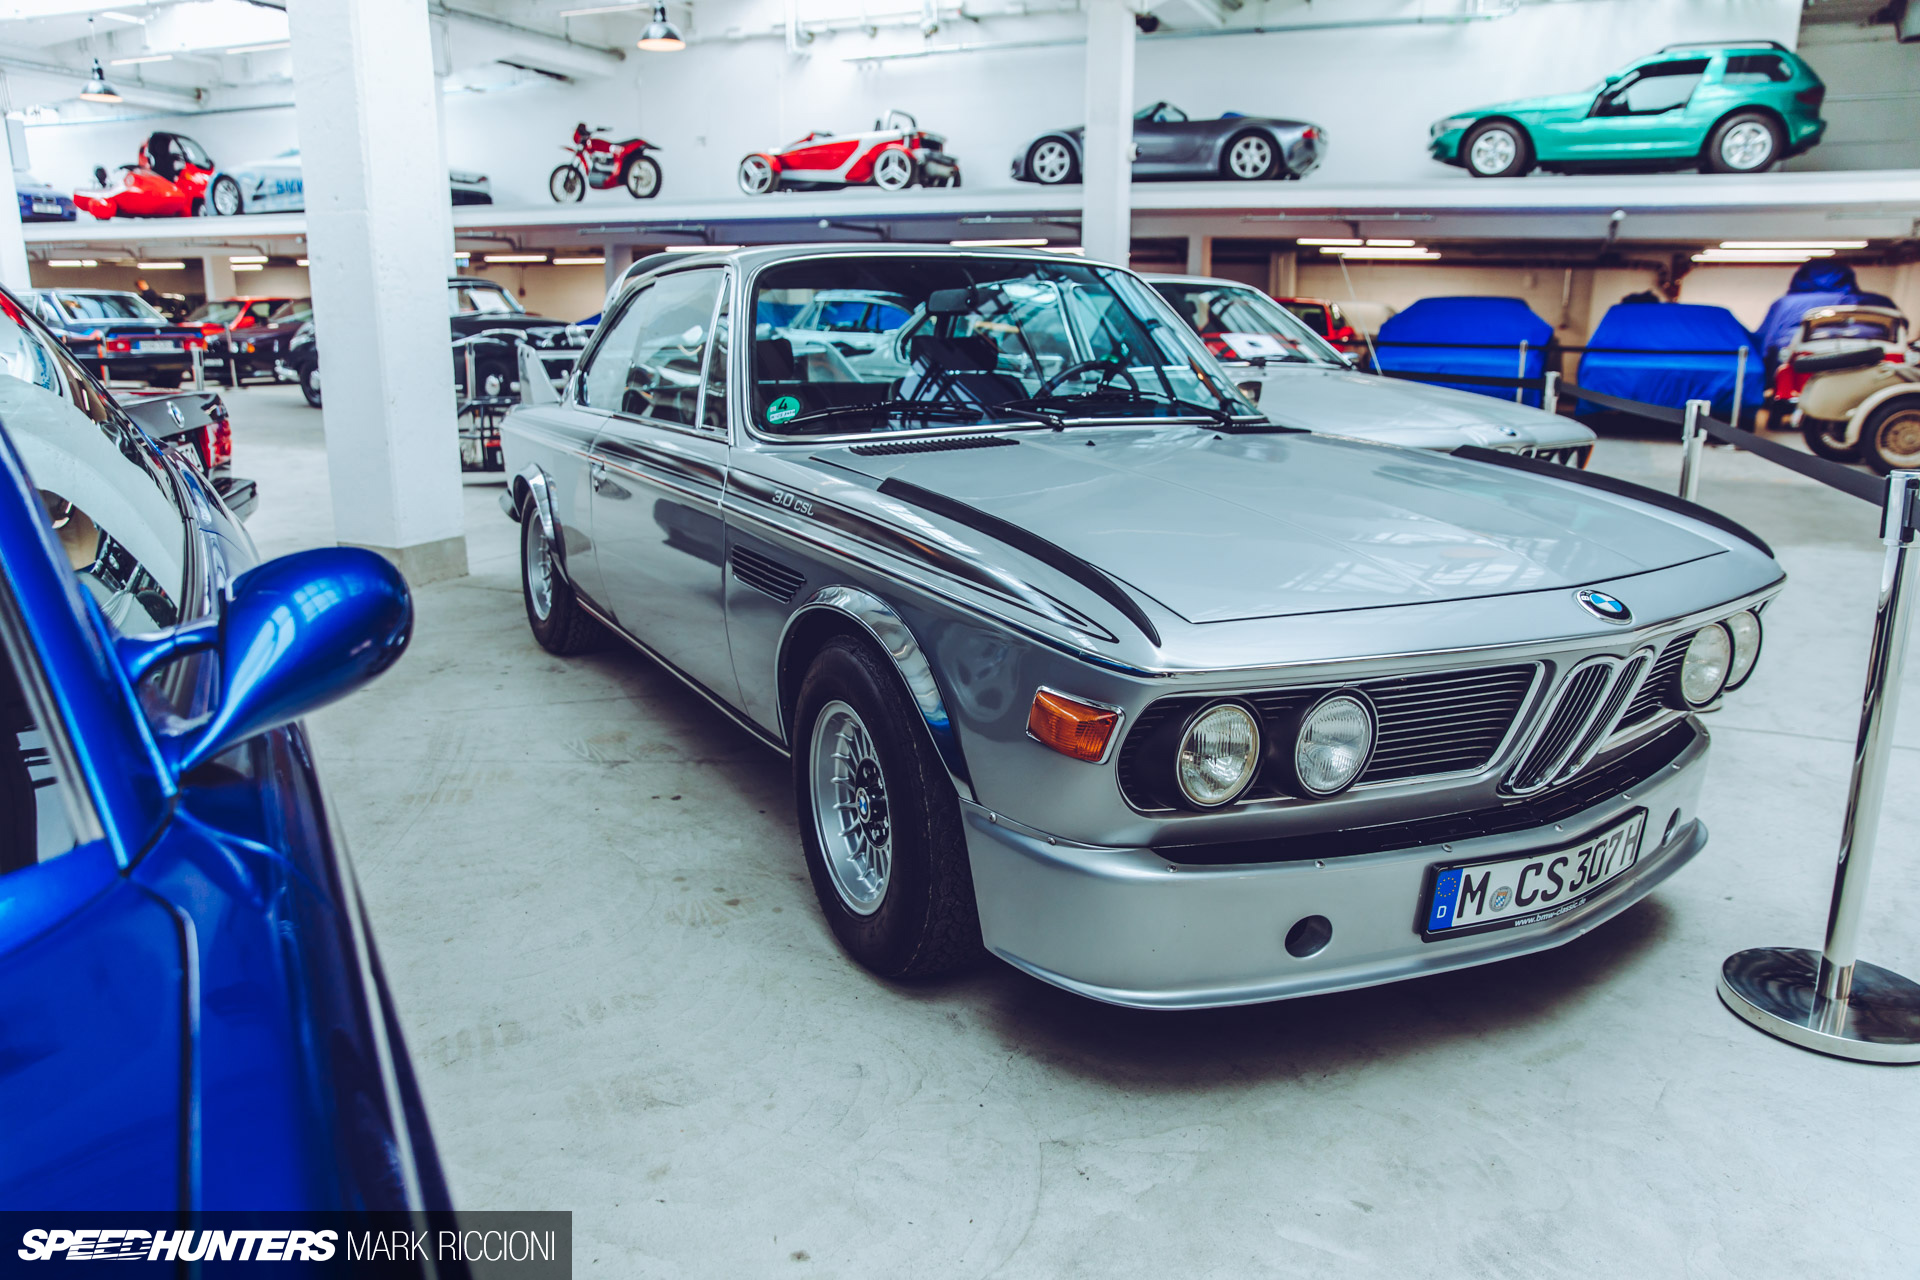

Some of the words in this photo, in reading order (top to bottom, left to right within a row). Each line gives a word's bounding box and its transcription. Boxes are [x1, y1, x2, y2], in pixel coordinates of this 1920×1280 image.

[778, 398, 788, 410] 4
[794, 499, 814, 516] CSL
[1456, 870, 1491, 918] M
[1514, 857, 1569, 907] CS
[1569, 819, 1642, 892] 307H
[1436, 905, 1447, 918] D
[1514, 897, 1587, 927] www.bmw-classic.de
